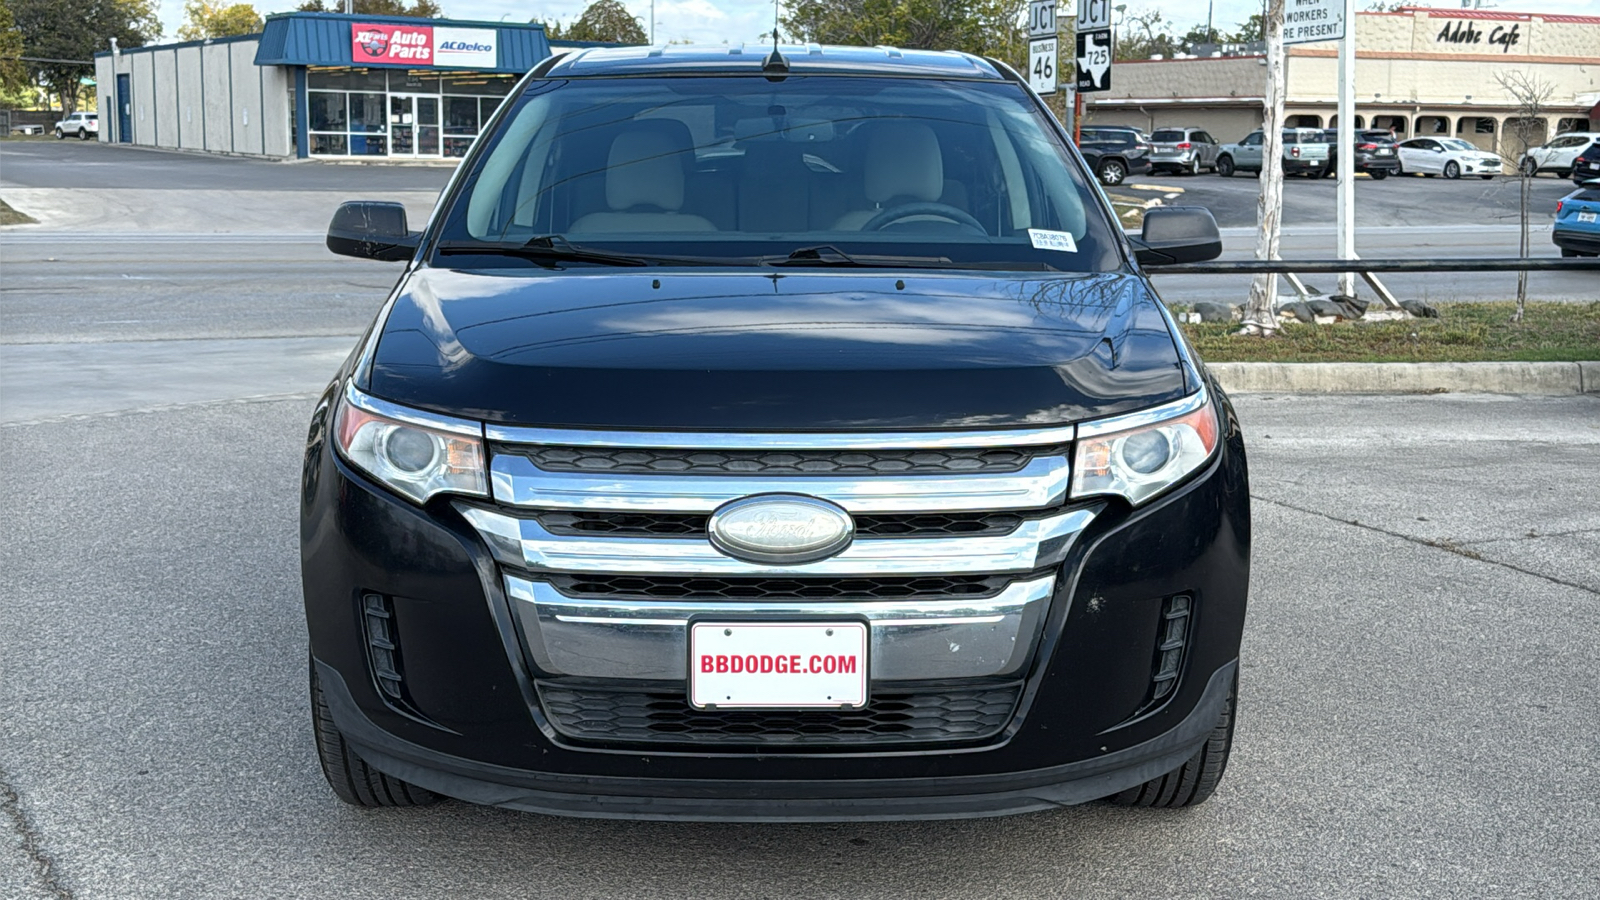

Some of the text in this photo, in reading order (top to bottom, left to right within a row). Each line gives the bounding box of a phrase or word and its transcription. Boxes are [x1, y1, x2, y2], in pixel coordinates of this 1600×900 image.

[1031, 5, 1055, 31] JCT
[1079, 0, 1106, 24] JCT
[1286, 8, 1328, 23] WORKERS
[390, 30, 427, 45] Auto
[1283, 23, 1338, 39] RE PRESENT
[1436, 21, 1520, 53] Adobe Cafe
[388, 44, 430, 59] Parts
[440, 41, 492, 52] ACDelco
[1033, 43, 1054, 54] BUSINESS
[1087, 50, 1107, 65] 725
[1034, 56, 1053, 79] 46
[746, 510, 816, 539] Ford
[701, 654, 857, 674] BBDODGE.COM
